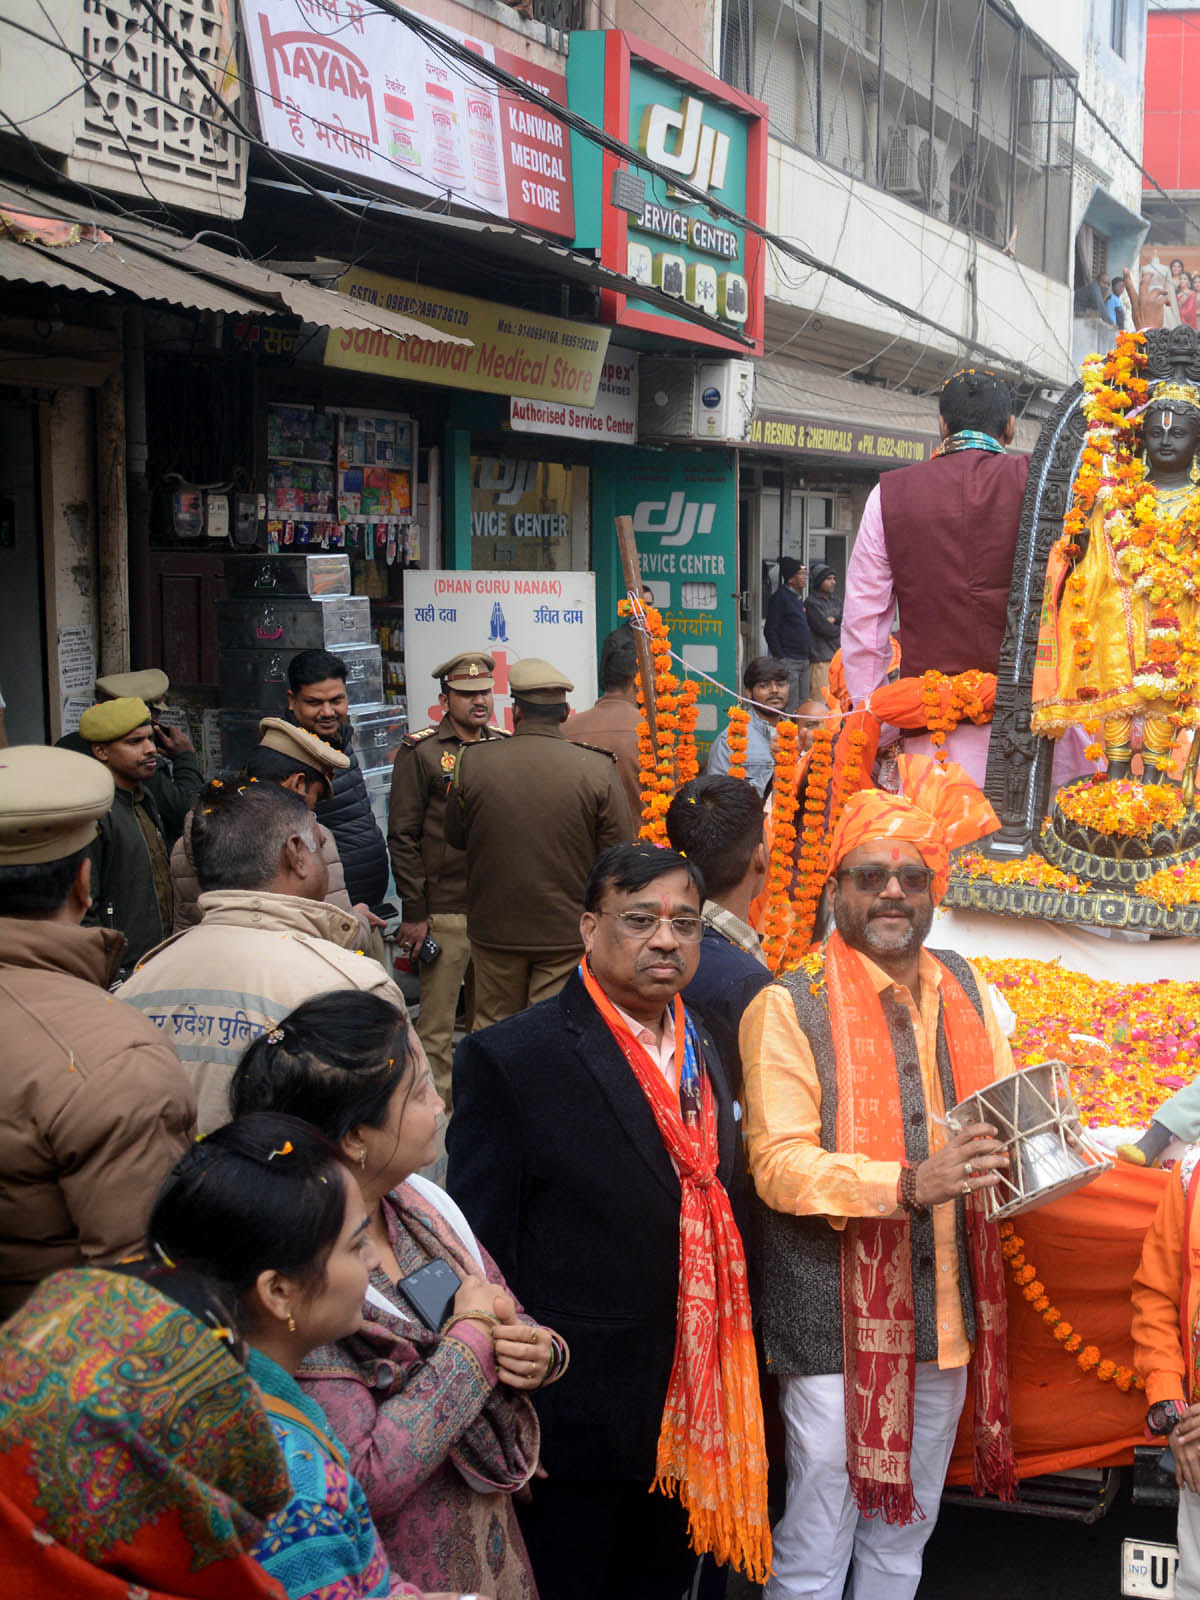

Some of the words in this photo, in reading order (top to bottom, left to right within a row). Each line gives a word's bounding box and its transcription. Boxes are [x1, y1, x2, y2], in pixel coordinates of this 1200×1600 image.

[258, 11, 379, 145] KAYAM
[508, 107, 563, 148] KANWAR
[511, 142, 566, 182] MEDICAL
[521, 180, 560, 214] STORE
[692, 222, 738, 259] CENTER
[350, 284, 379, 305] GSTIN
[339, 327, 391, 358] Sant
[476, 342, 551, 385] Medical
[552, 355, 594, 394] Store
[512, 401, 566, 428] Authorised
[568, 409, 604, 431] Service
[606, 415, 635, 437] Center
[764, 420, 798, 447] RESINS
[798, 426, 805, 448] &
[807, 426, 854, 453] CHEMICALS
[513, 511, 568, 537] CENTER
[678, 553, 726, 576] CENTER
[433, 578, 473, 598] (DHAN
[475, 579, 511, 596] GURU
[513, 579, 562, 598] NANAK)
[414, 603, 435, 624] सही
[439, 607, 457, 624] दवा
[532, 605, 560, 625] उचित
[563, 608, 584, 625] दाम
[170, 1004, 216, 1037] प्रदेश
[886, 1323, 906, 1346] श्री
[1128, 1564, 1148, 1576] IND
[1150, 1555, 1179, 1589] U
